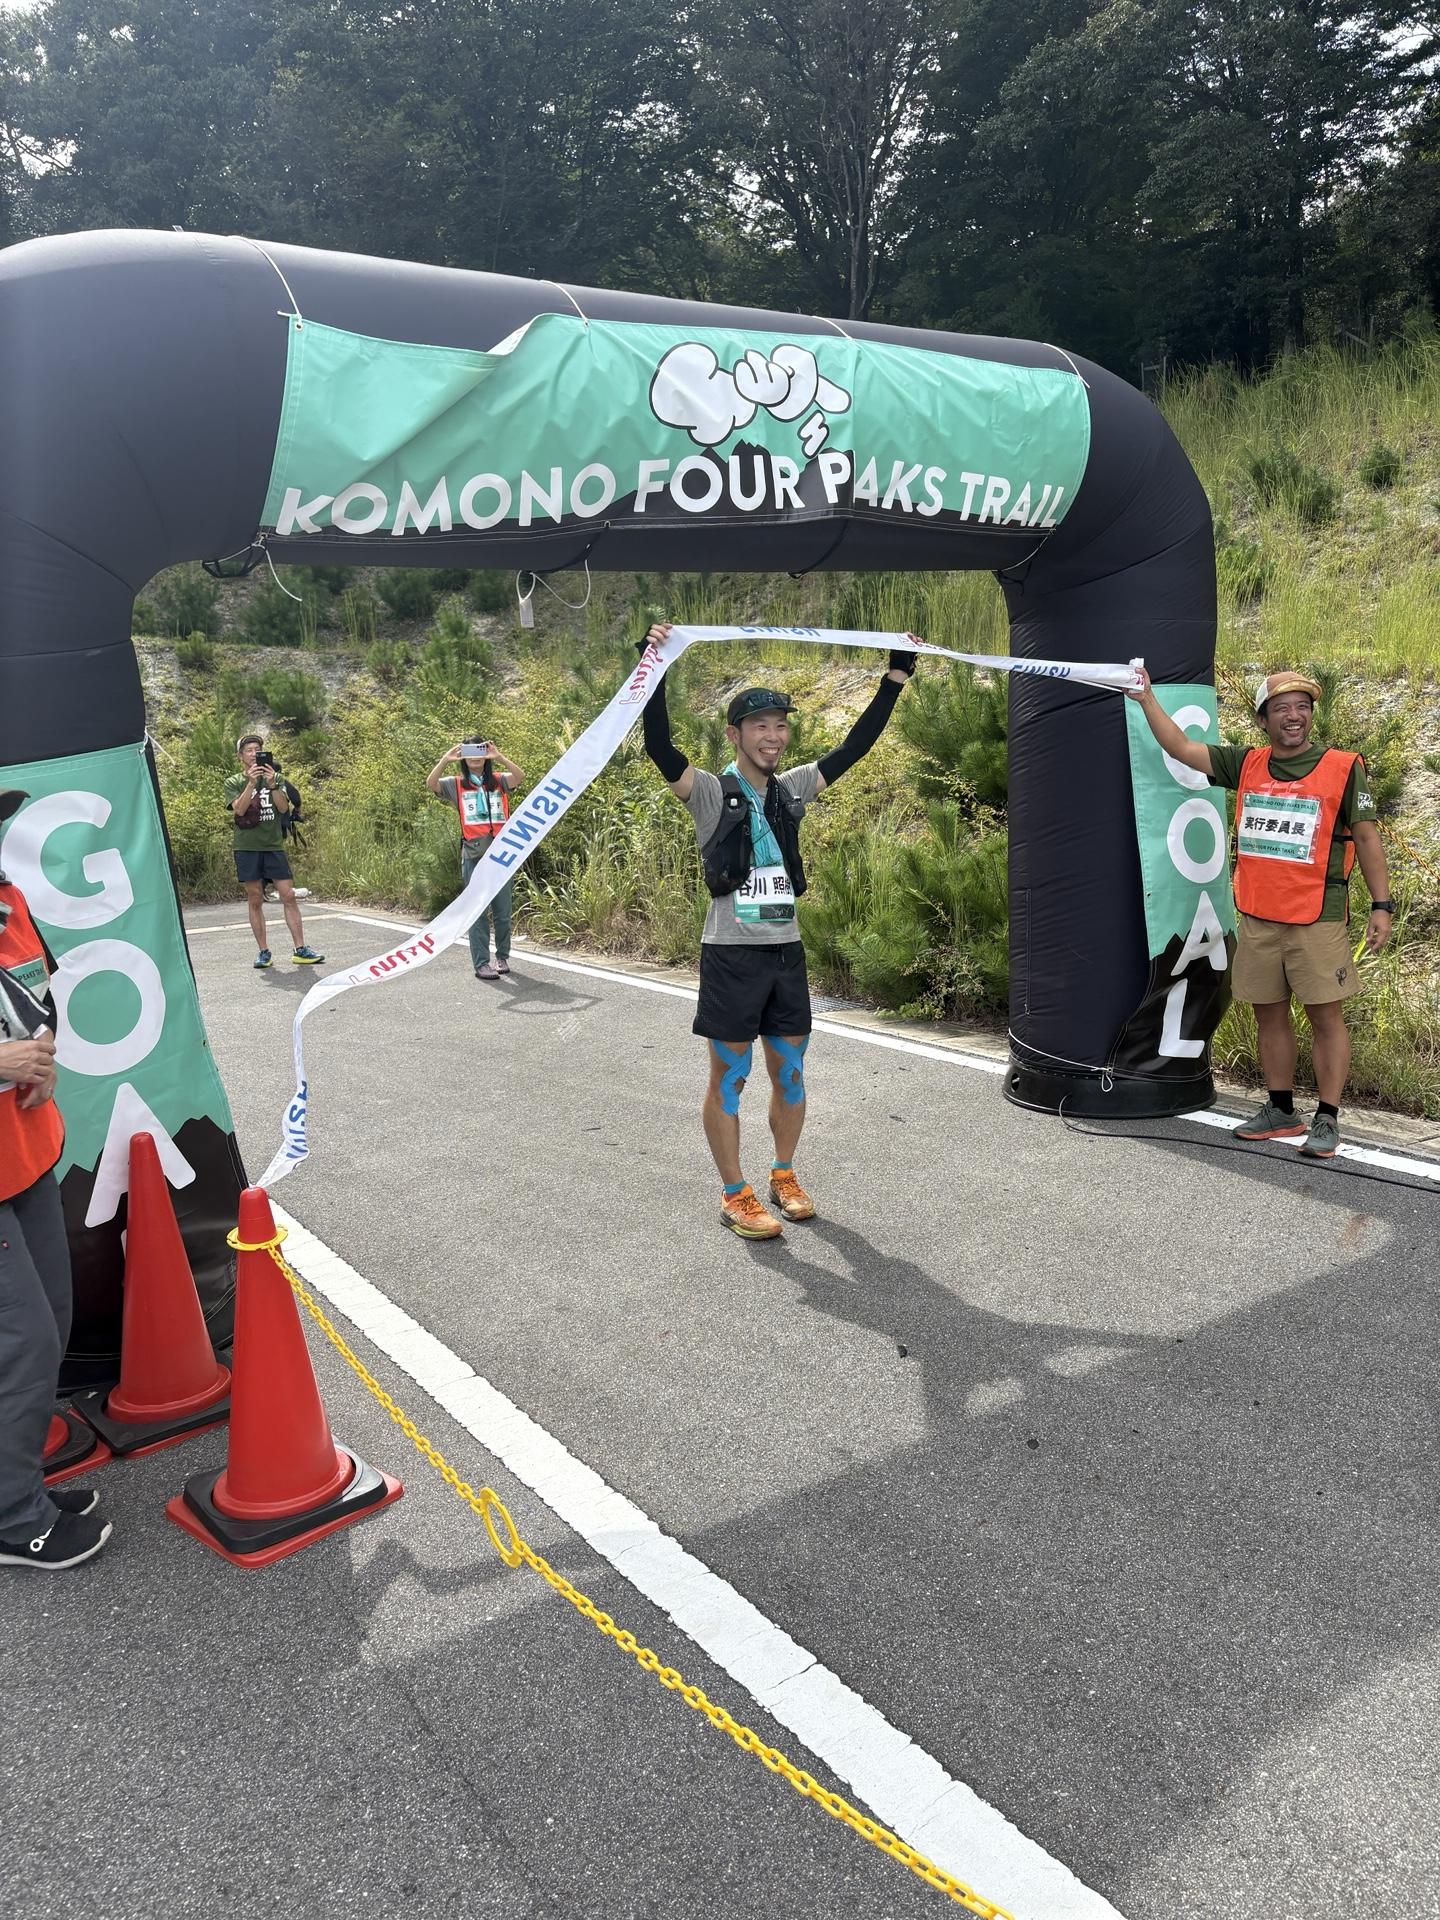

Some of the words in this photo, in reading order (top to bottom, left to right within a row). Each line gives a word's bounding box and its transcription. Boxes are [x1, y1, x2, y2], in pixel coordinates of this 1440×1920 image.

[275, 462, 617, 536] KOMONO
[633, 454, 806, 513] FOUR
[959, 470, 1065, 528] TRAIL
[1244, 816, 1306, 836] 実行委員長
[1, 790, 197, 1258] GOA
